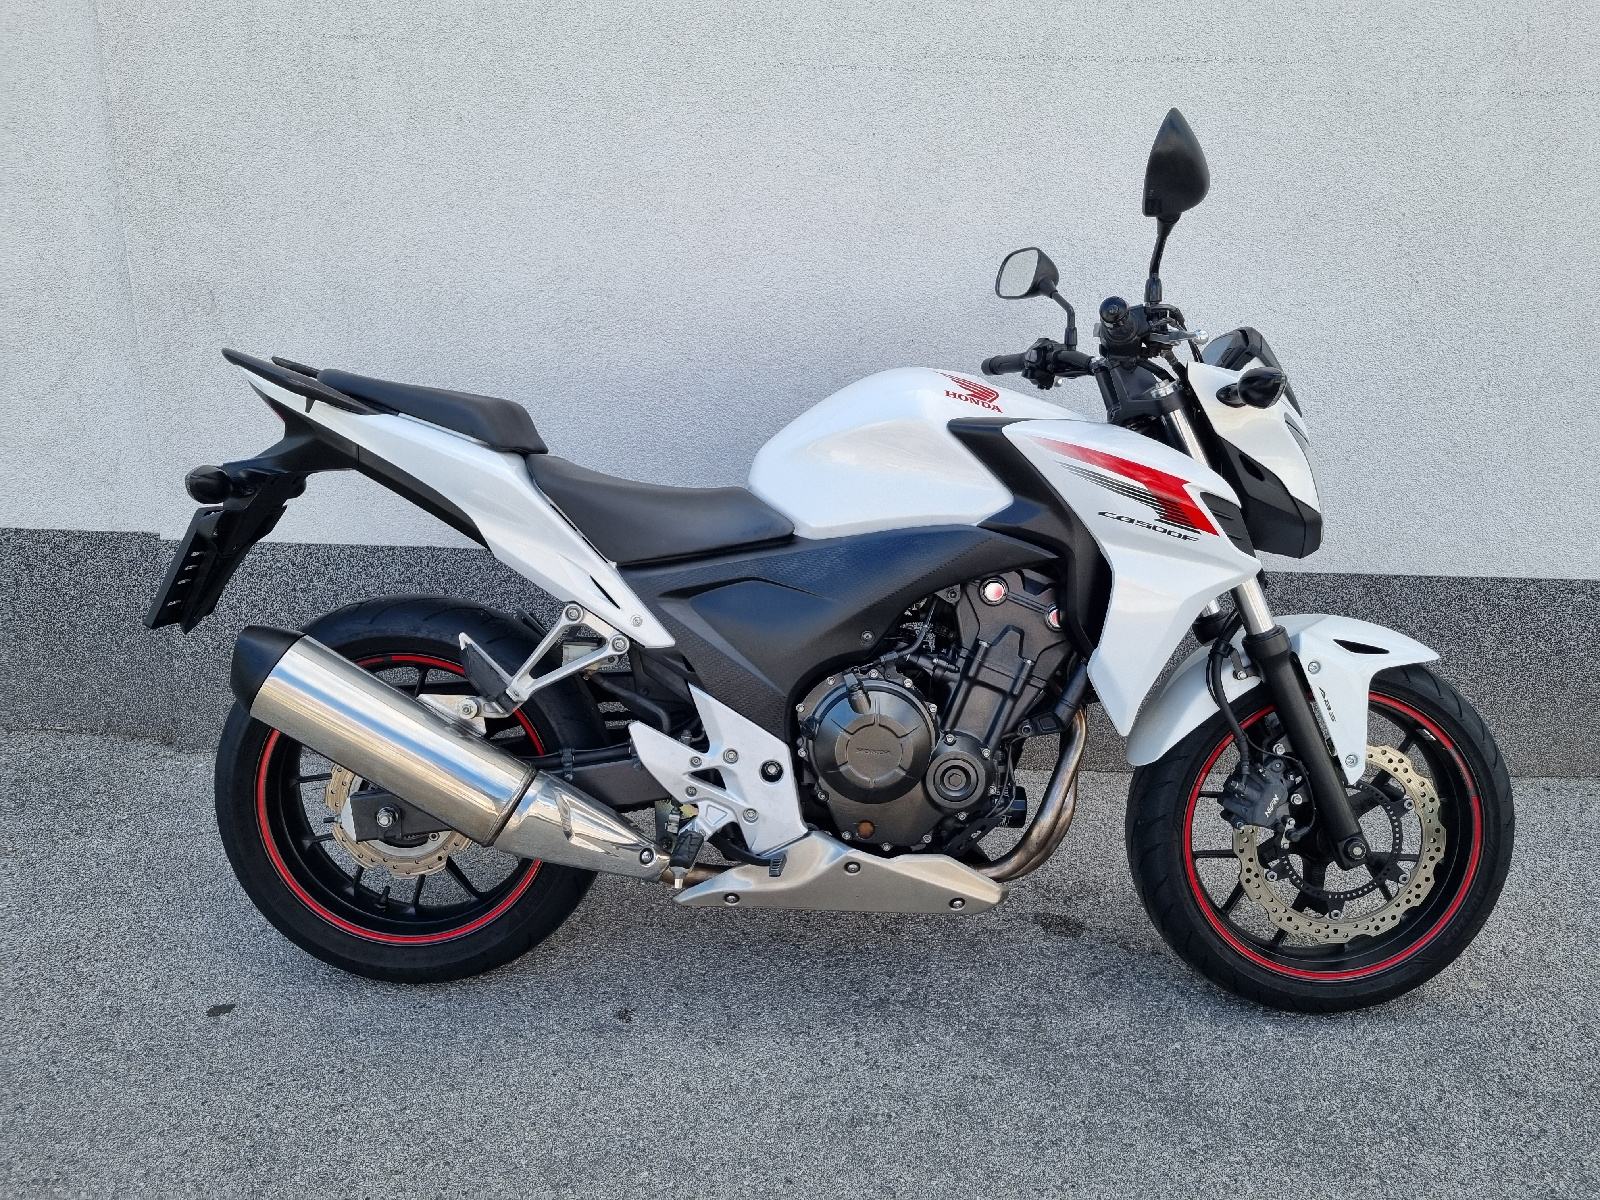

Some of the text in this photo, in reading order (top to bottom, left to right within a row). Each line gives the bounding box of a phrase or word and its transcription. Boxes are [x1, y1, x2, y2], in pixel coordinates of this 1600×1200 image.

[944, 390, 1003, 413] HONDA
[1098, 511, 1200, 541] CB500F
[1318, 686, 1337, 722] ABS
